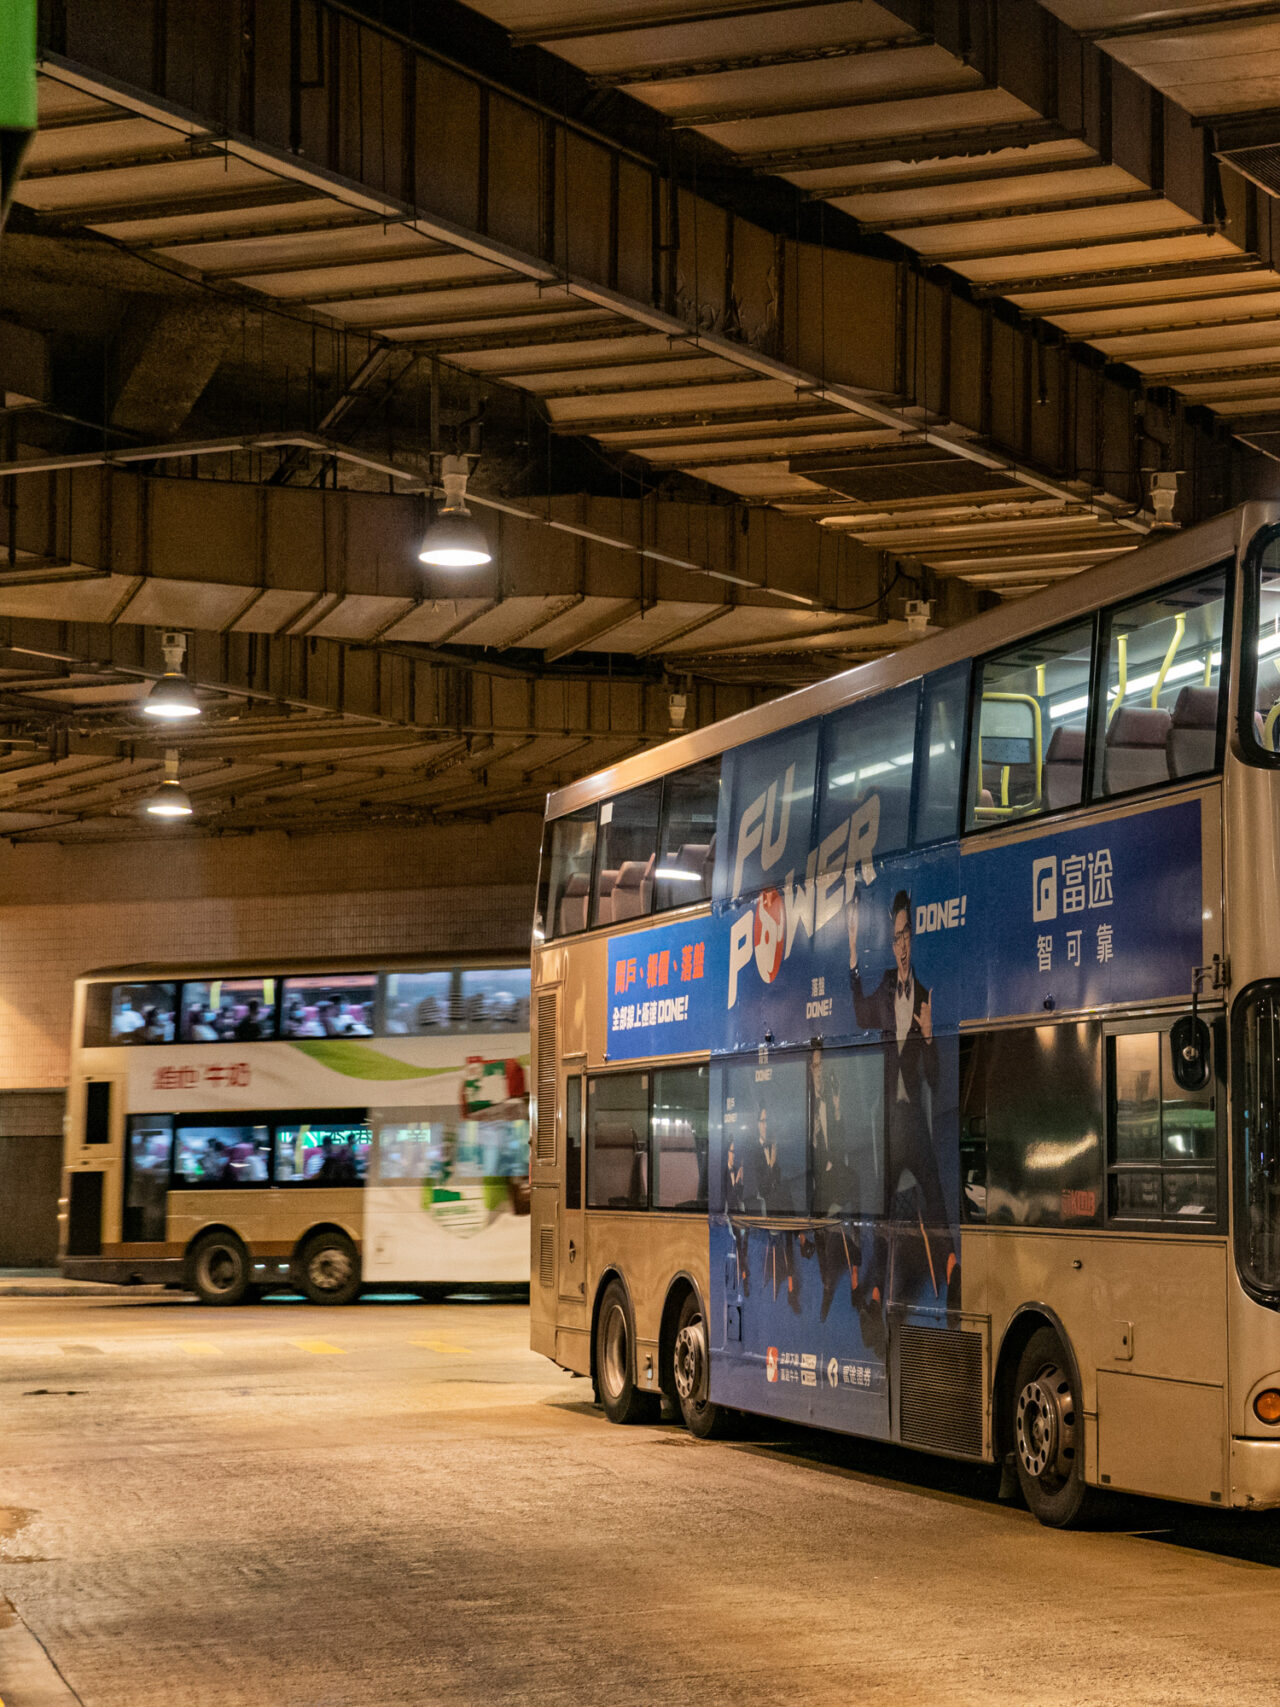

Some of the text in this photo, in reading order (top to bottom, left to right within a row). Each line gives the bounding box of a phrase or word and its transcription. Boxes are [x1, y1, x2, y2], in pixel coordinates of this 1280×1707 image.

[733, 761, 796, 900] FU
[1061, 848, 1114, 914] 富途
[916, 895, 967, 935] DONE!
[806, 998, 833, 1020] DONE!
